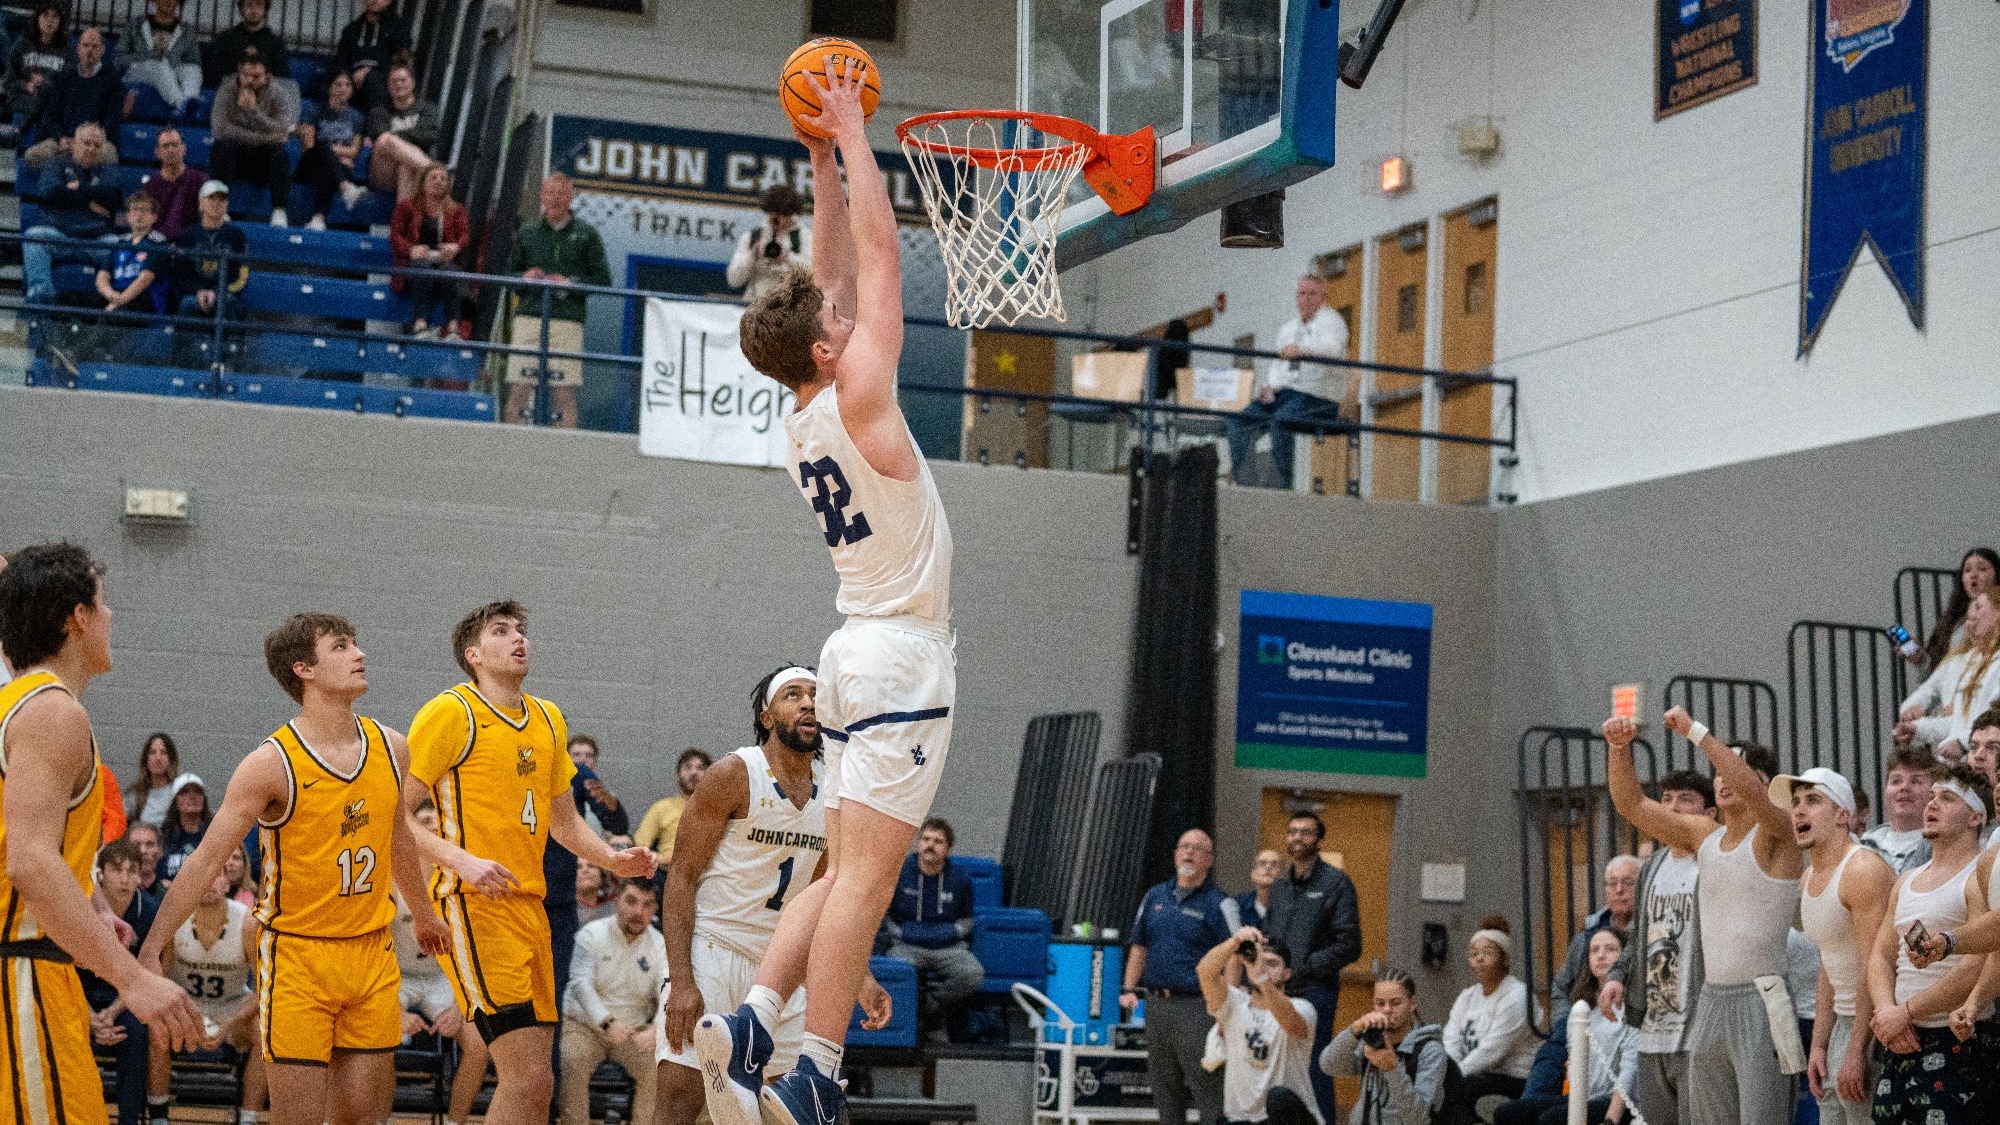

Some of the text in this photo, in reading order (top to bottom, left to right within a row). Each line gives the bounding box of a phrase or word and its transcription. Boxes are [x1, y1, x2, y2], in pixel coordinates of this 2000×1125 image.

[576, 137, 706, 186] JOHN
[631, 211, 738, 243] TRACK
[646, 358, 675, 413] The
[799, 455, 873, 548] 32
[1286, 641, 1413, 670] Cleveland Clinic
[1288, 664, 1375, 685] Sports Medicine
[521, 788, 537, 835] 4
[337, 845, 376, 897] 12
[765, 856, 795, 912] 1
[187, 972, 224, 999] 33
